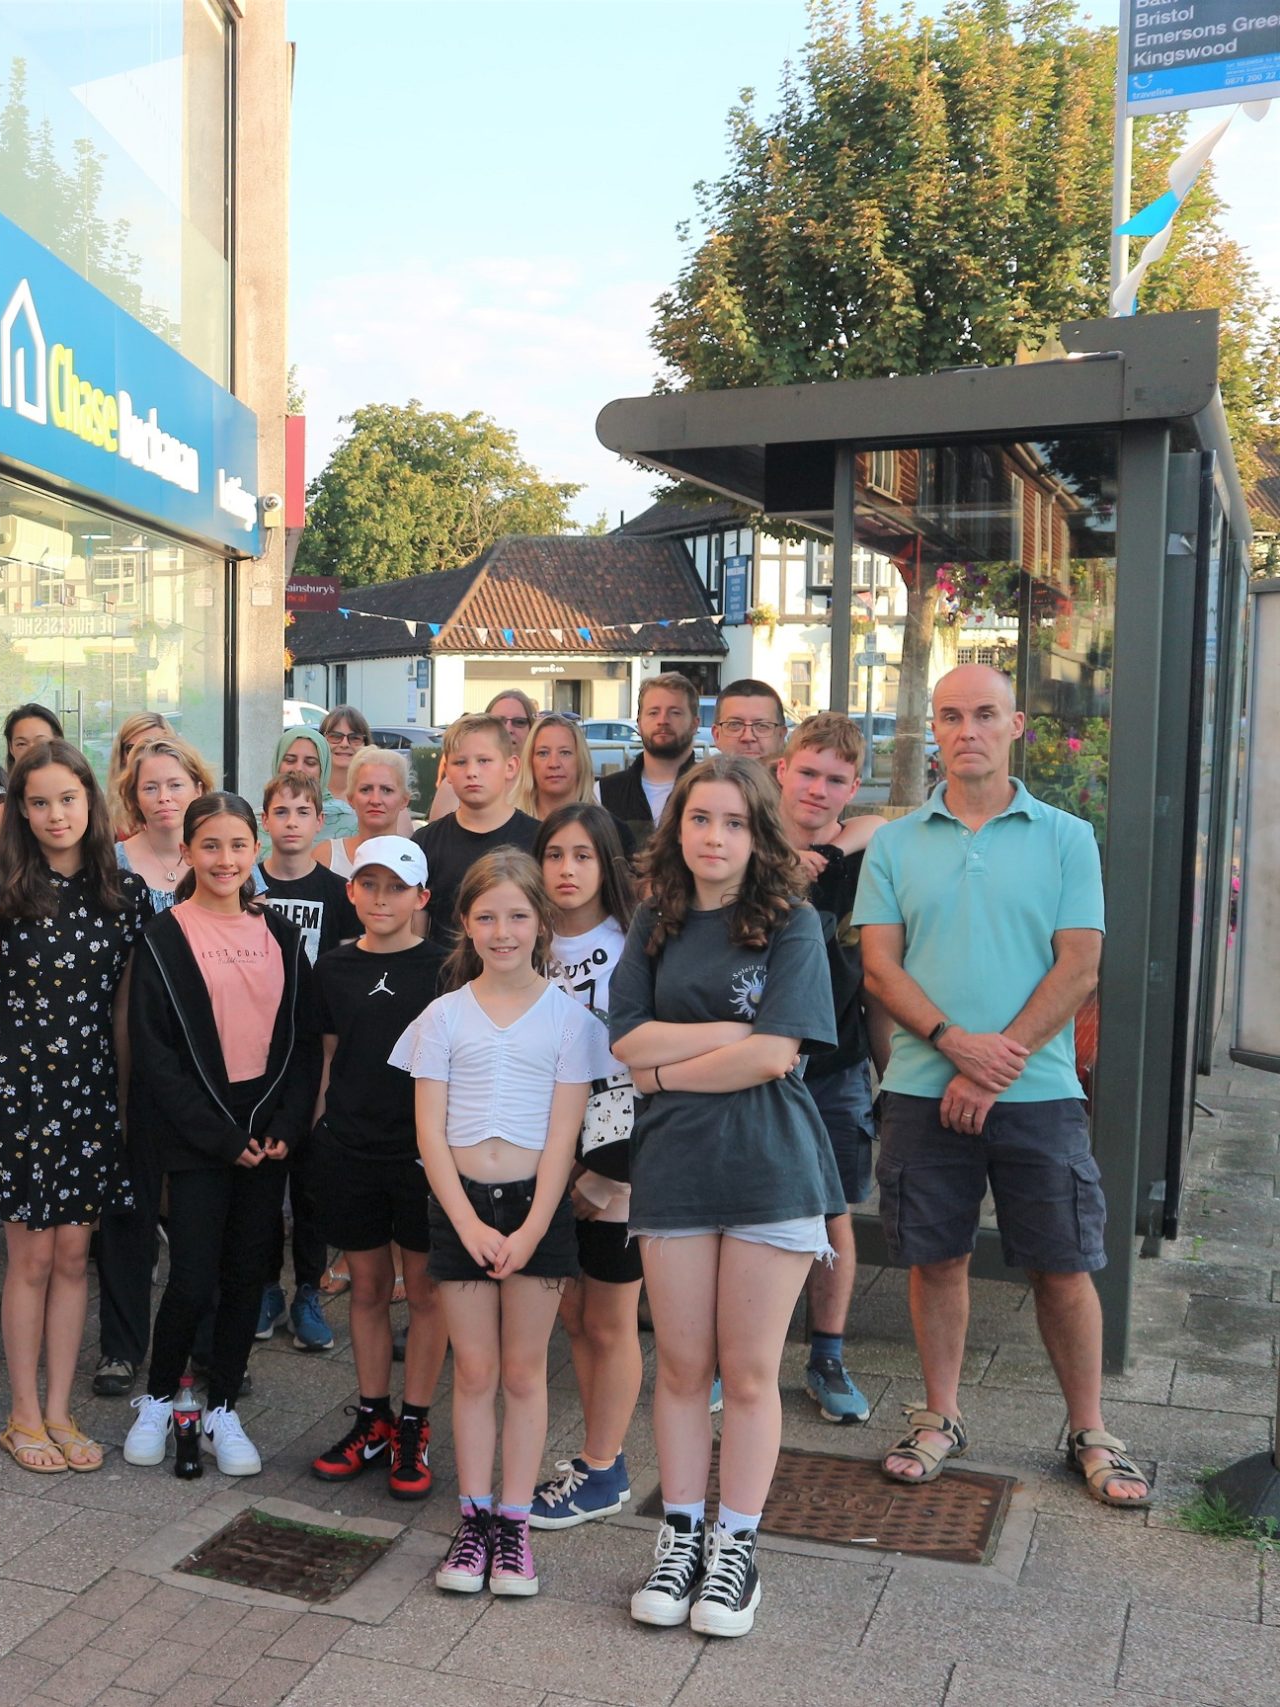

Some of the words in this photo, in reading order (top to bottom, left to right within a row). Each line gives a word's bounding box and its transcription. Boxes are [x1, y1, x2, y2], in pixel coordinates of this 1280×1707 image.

[1136, 5, 1194, 28] Bristol
[1134, 22, 1227, 48] Emersons
[1232, 15, 1280, 33] Gree
[1134, 38, 1238, 67] Kingswood
[1132, 87, 1175, 100] traveline
[49, 342, 118, 453] Chase
[287, 584, 335, 596] ainsbury's
